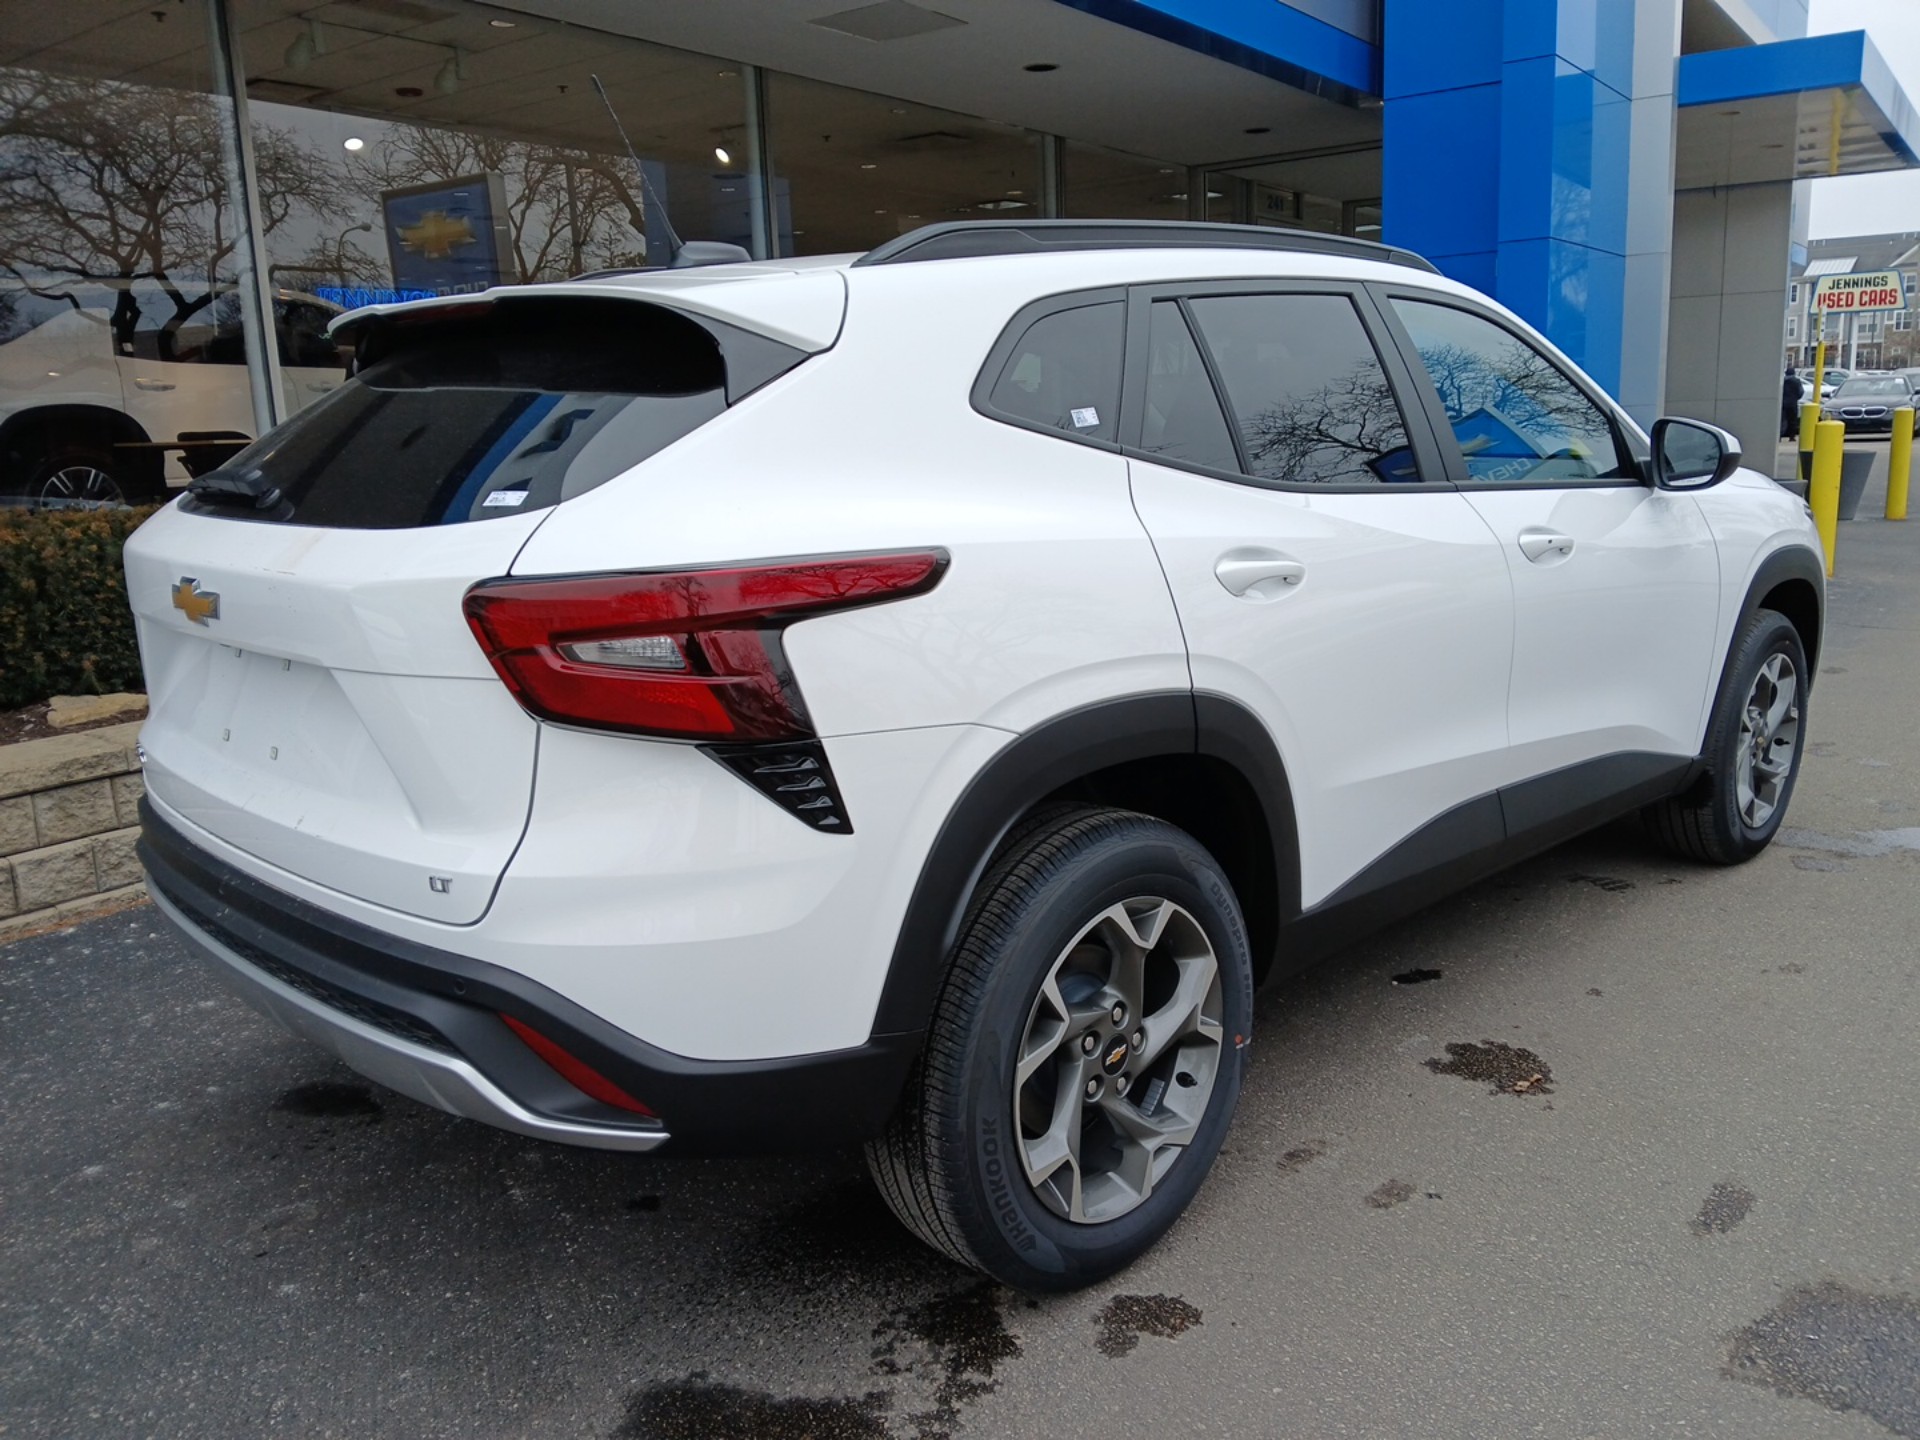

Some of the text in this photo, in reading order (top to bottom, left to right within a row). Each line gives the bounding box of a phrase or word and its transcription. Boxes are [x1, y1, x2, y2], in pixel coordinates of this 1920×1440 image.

[1266, 194, 1284, 211] 241
[1828, 275, 1888, 290] JENNINGS
[1817, 288, 1898, 309] USED CARS
[428, 876, 453, 894] LT
